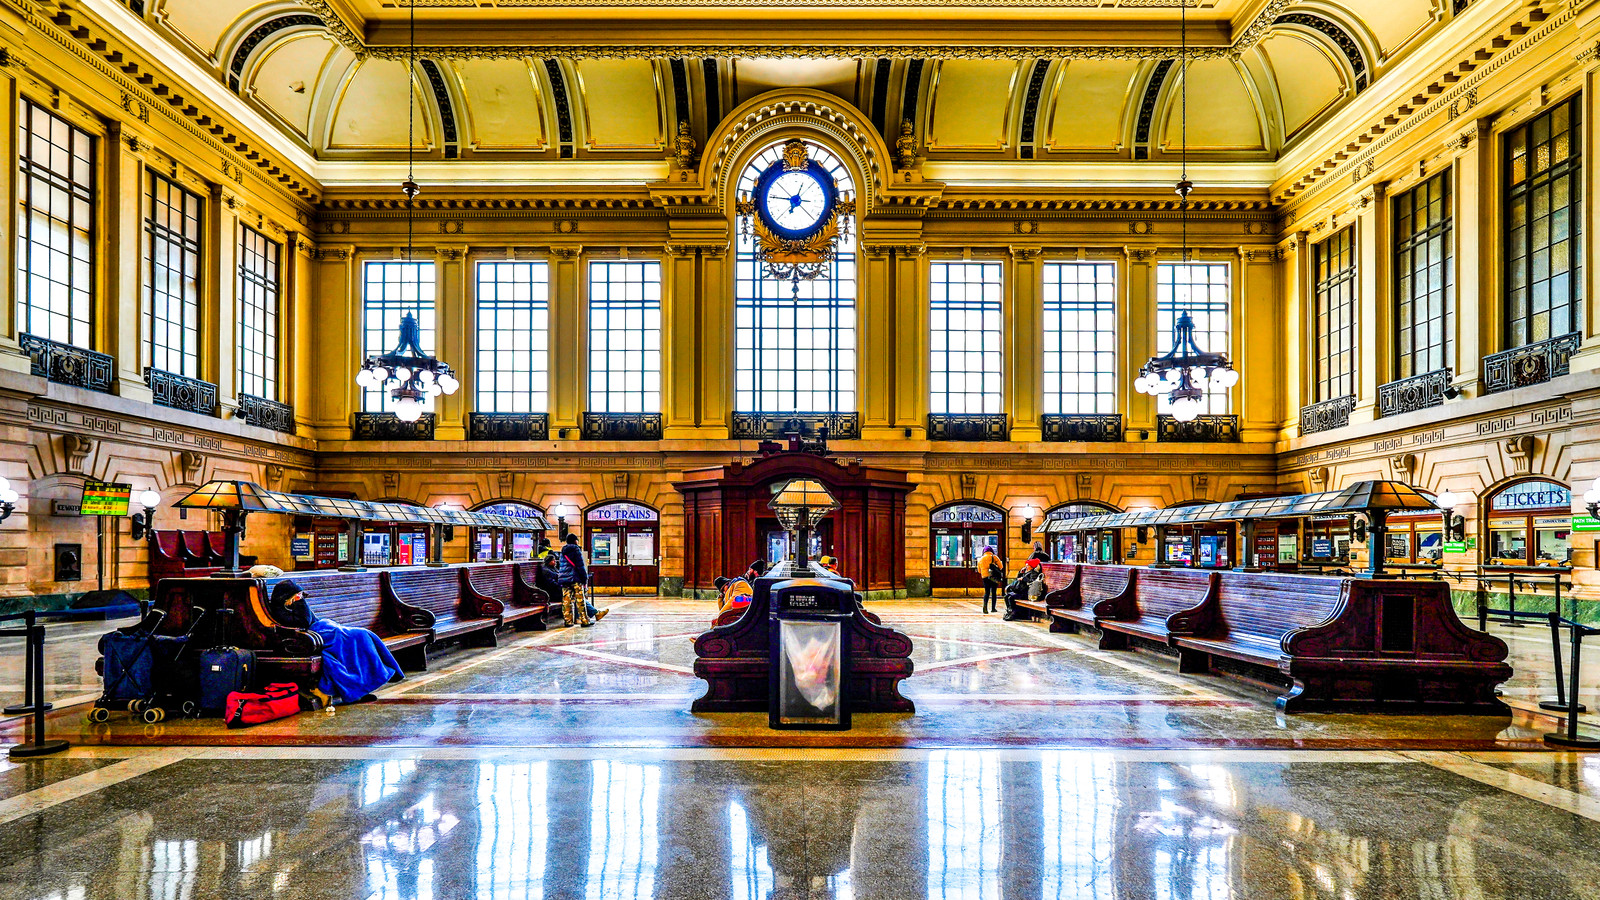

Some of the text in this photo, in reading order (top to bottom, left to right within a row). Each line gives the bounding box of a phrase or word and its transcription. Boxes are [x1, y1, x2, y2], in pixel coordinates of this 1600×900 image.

[1503, 490, 1564, 506] TICKETS
[597, 510, 651, 519] TO TRAINS
[942, 511, 996, 521] TO TRAINS
[1057, 511, 1071, 520] TO
